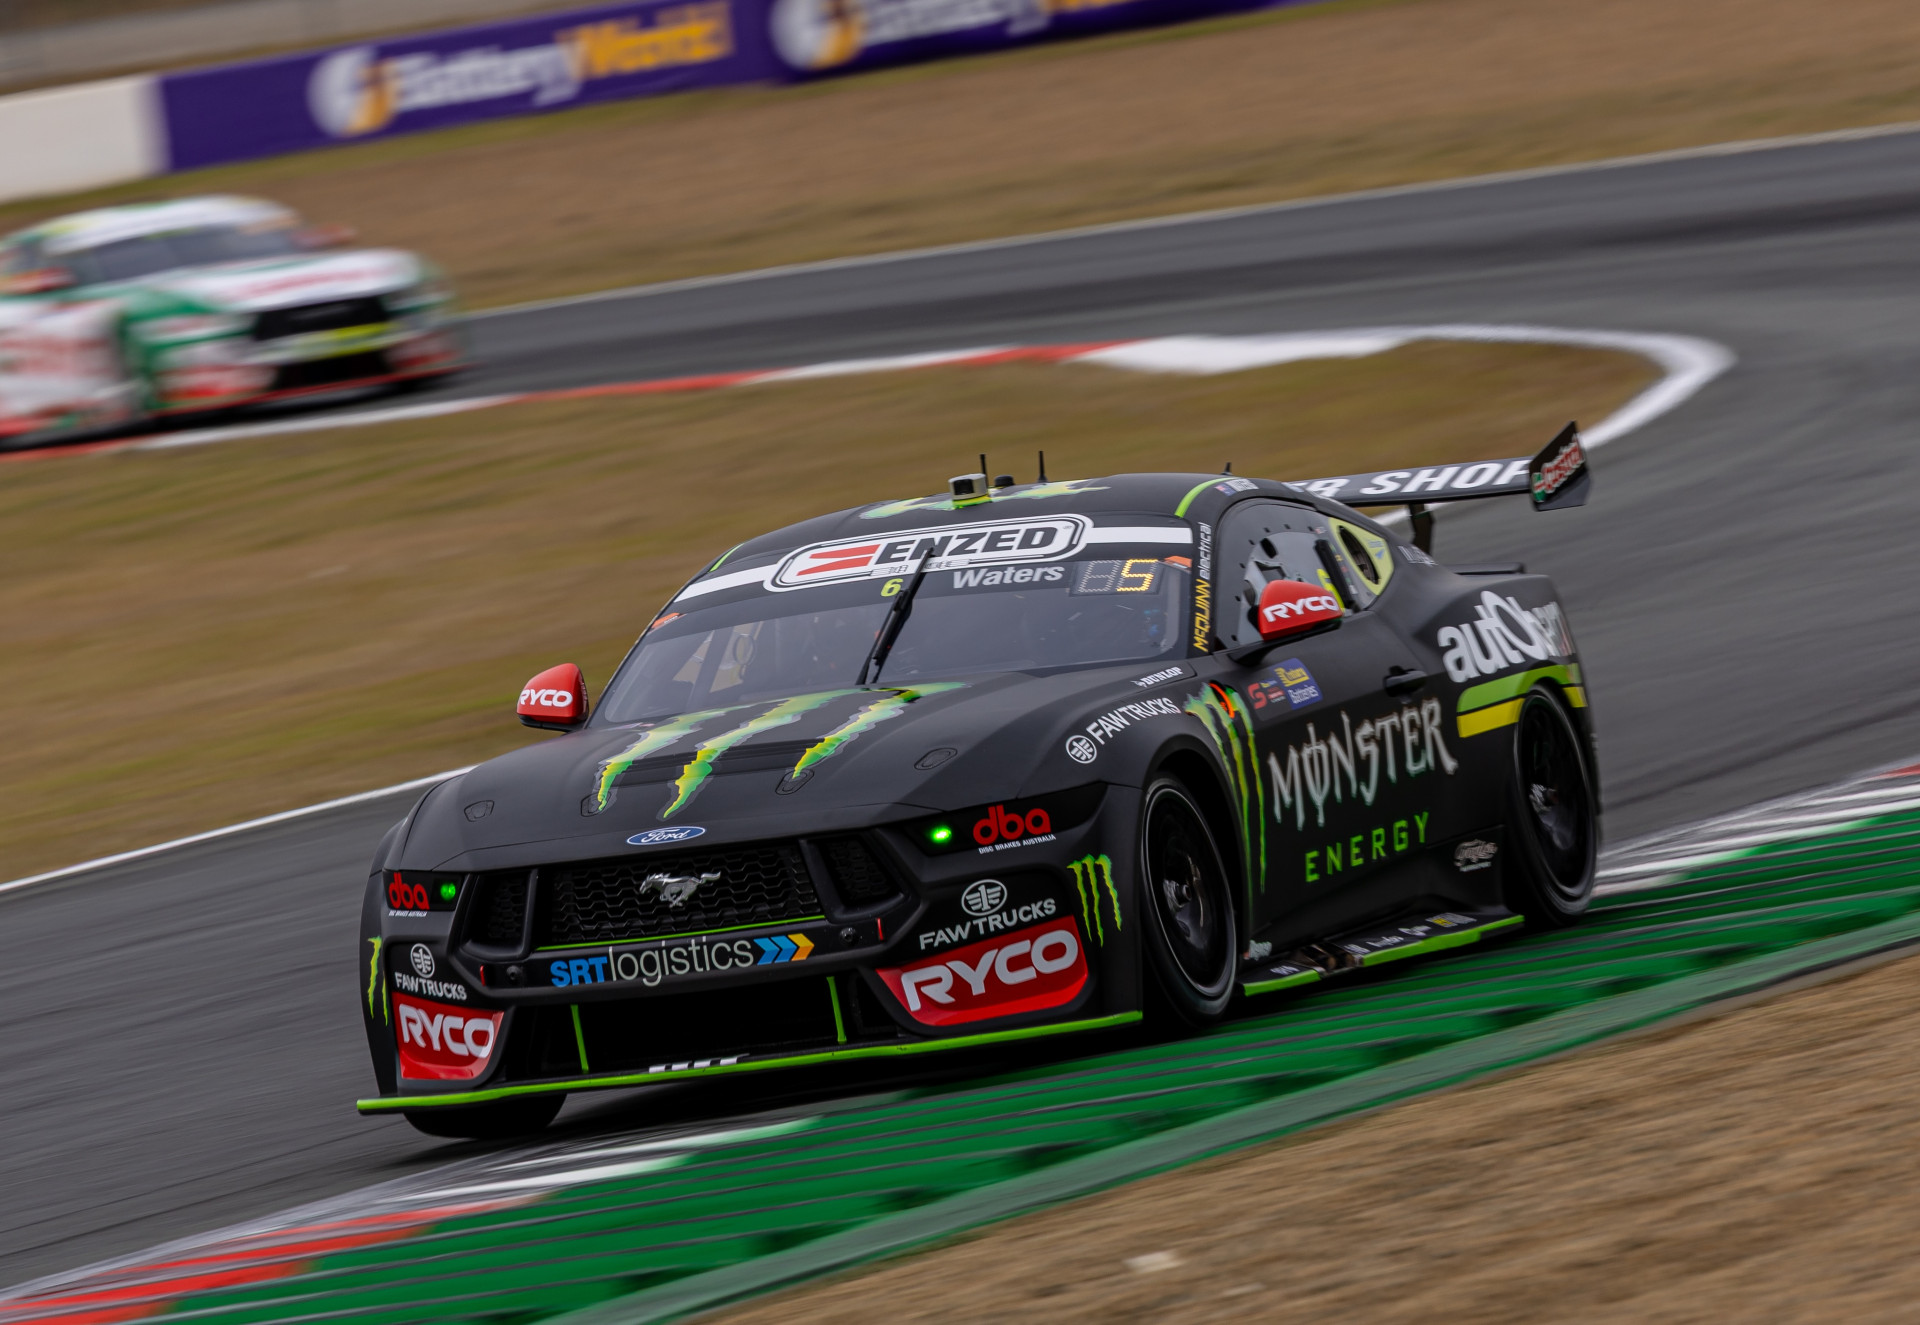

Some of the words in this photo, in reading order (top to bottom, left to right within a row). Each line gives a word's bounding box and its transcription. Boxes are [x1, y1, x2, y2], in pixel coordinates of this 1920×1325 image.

[874, 526, 1058, 565] ENZED
[880, 578, 904, 597] 6
[953, 565, 1066, 589] Waters
[1263, 595, 1339, 623] RYCO
[1140, 666, 1183, 686] DUNLOP
[520, 688, 573, 708] RYCO
[1086, 710, 1131, 745] FAW
[1117, 697, 1182, 721] TRUCKS
[641, 828, 692, 843] Ford
[973, 804, 1052, 846] dba
[978, 843, 994, 855] DISC
[995, 840, 1022, 851] BRAKES
[1022, 833, 1057, 847] AUSTRALIA
[1305, 811, 1430, 883] ENERGY
[388, 872, 430, 910] dba
[919, 921, 971, 951] FAW
[972, 898, 1057, 936] TRUCKS
[550, 956, 608, 988] SRT
[608, 936, 755, 987] logistics
[900, 929, 1079, 1012] RYCO
[394, 972, 419, 993] FAW
[419, 978, 467, 1001] TRUCKS
[398, 1003, 495, 1058] RYCO
